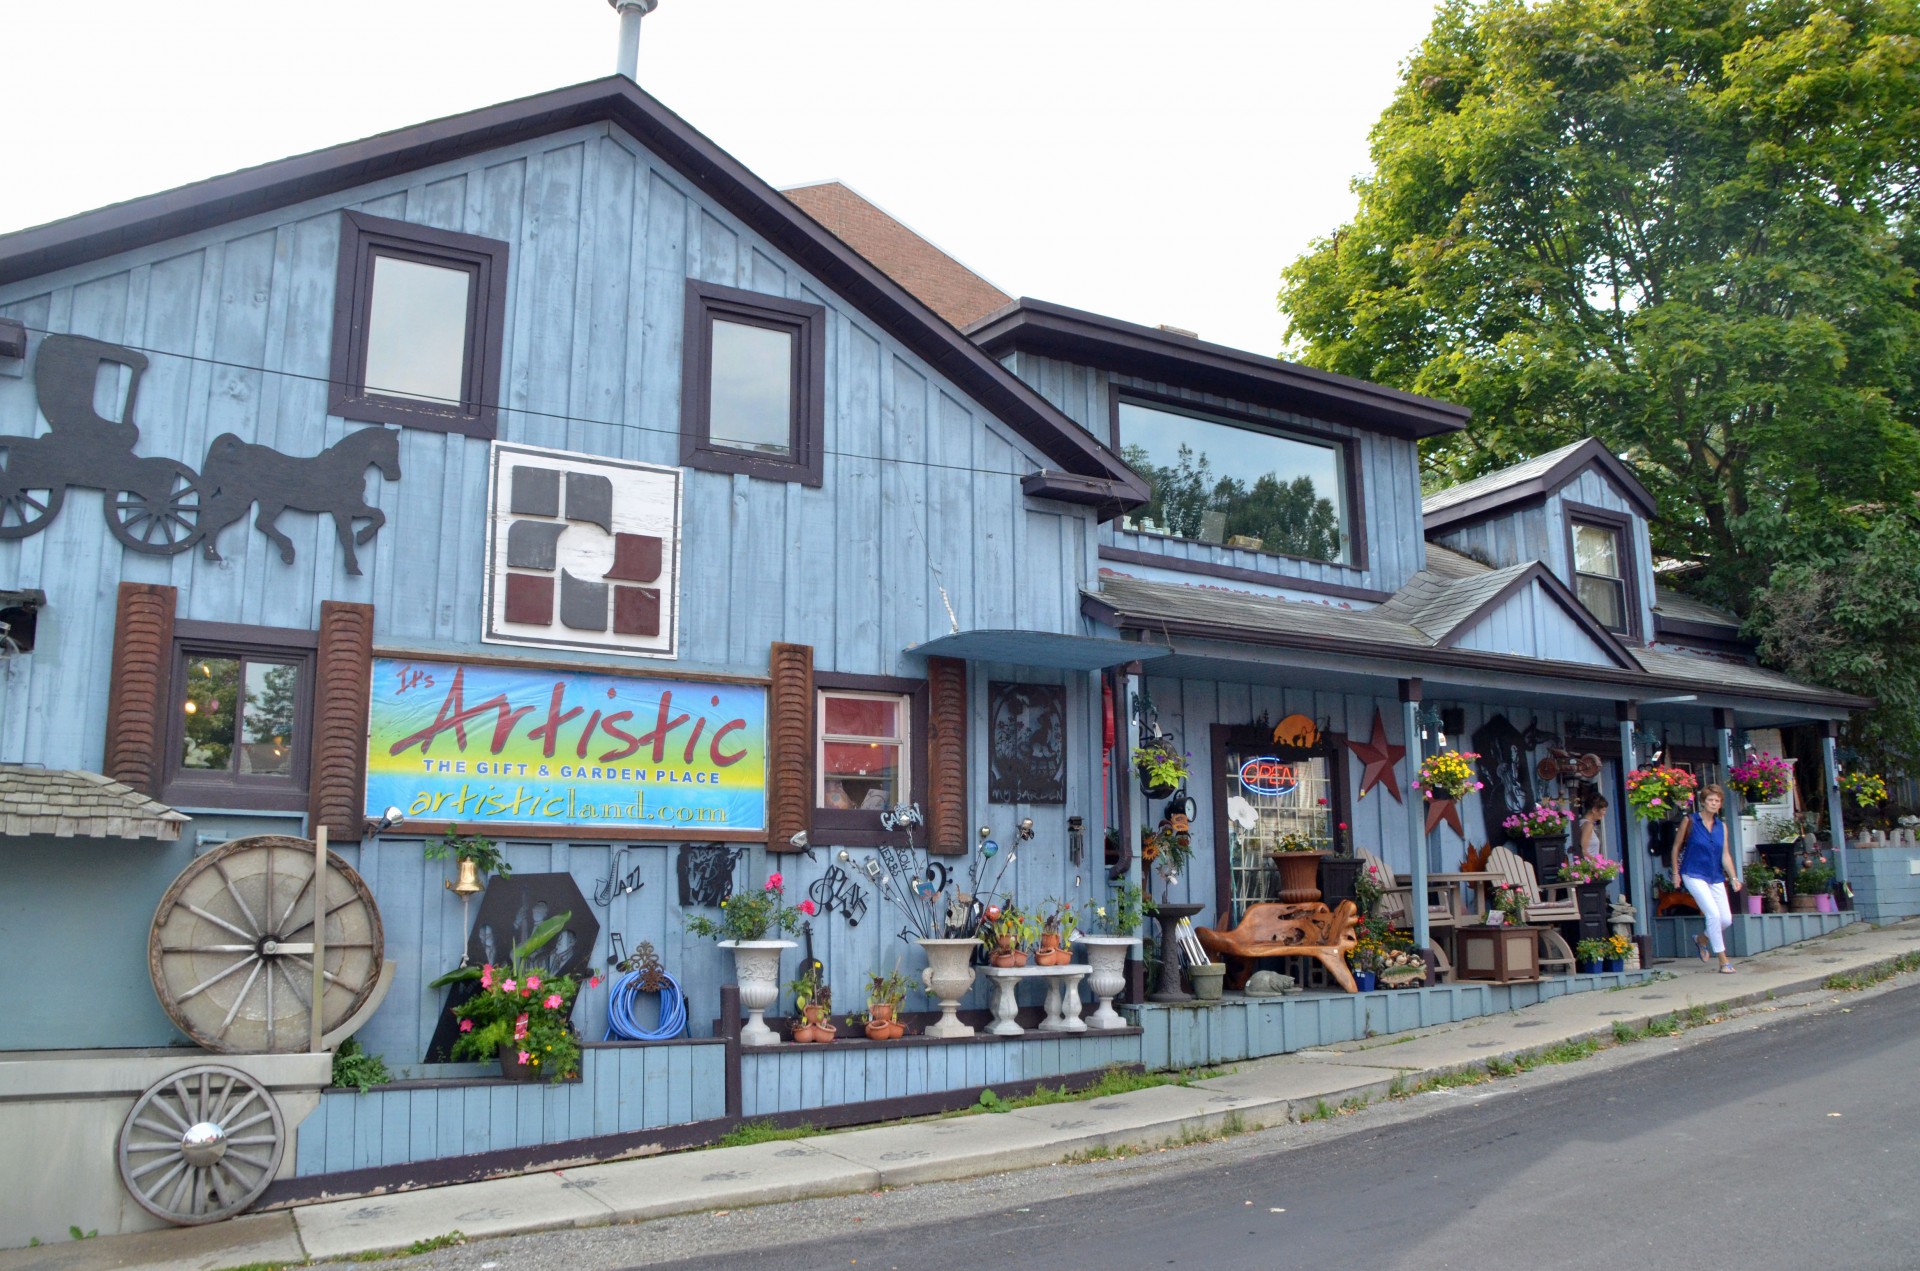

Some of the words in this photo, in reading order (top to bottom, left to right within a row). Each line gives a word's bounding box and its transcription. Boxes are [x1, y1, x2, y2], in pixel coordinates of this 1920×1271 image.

[389, 667, 748, 767] Artistic
[423, 759, 467, 774] THE
[476, 761, 528, 777] GIFT
[538, 764, 550, 777] &
[560, 765, 647, 781] GARDEN
[656, 770, 720, 784] PLACE
[1243, 763, 1299, 786] OPEN
[408, 783, 728, 823] artisticland.com
